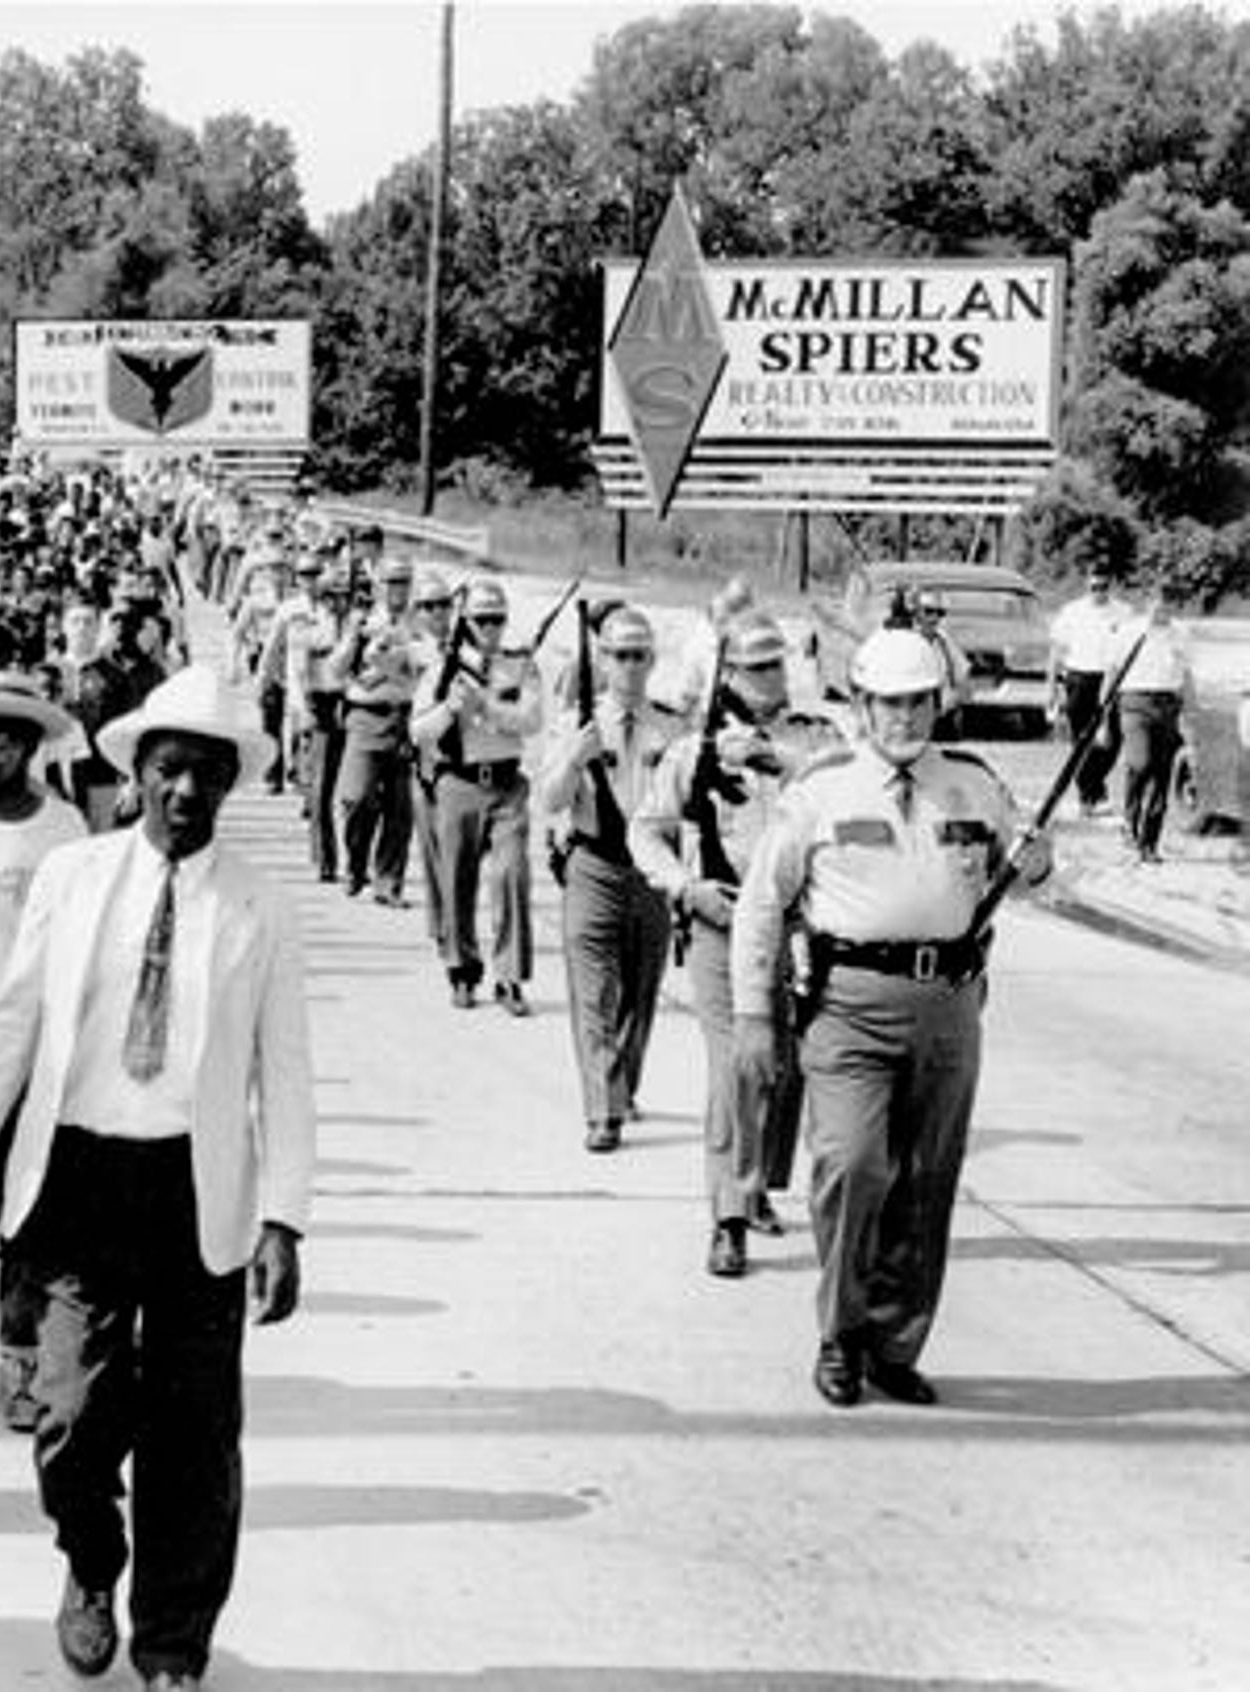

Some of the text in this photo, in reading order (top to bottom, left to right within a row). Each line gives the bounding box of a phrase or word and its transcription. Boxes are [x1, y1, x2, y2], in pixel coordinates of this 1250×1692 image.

[724, 277, 1048, 322] McMILLAN
[759, 331, 983, 375] SPIERS
[630, 364, 696, 430] S
[727, 379, 831, 407] REALTY
[850, 379, 1037, 407] CONSTRUCTION
